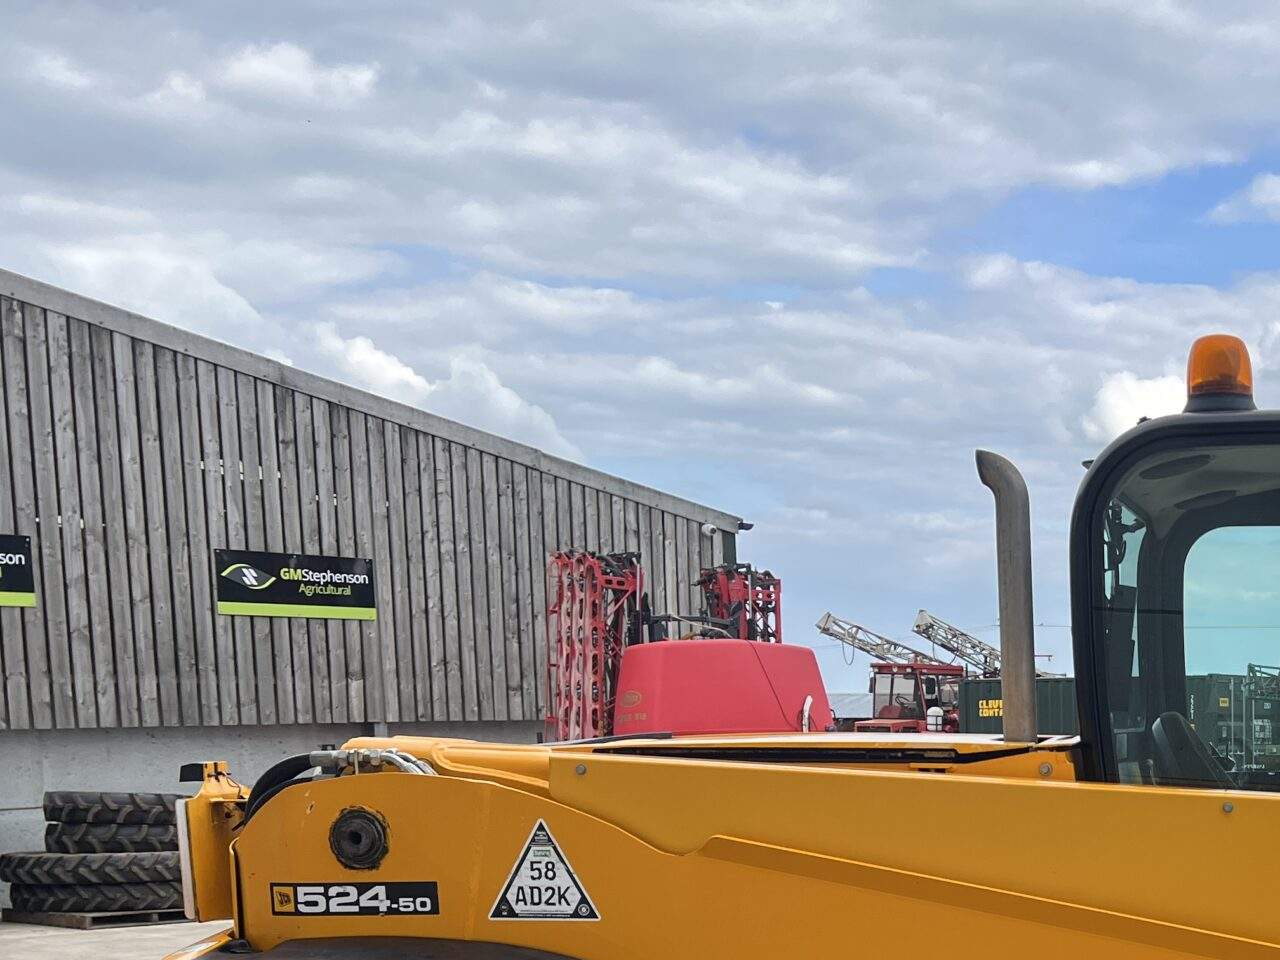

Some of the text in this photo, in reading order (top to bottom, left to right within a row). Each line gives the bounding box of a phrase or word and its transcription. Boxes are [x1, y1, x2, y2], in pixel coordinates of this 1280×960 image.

[280, 567, 369, 584] GMStephenson
[299, 583, 351, 596] Agricultural
[529, 860, 557, 881] 58
[514, 886, 571, 906] AD2K
